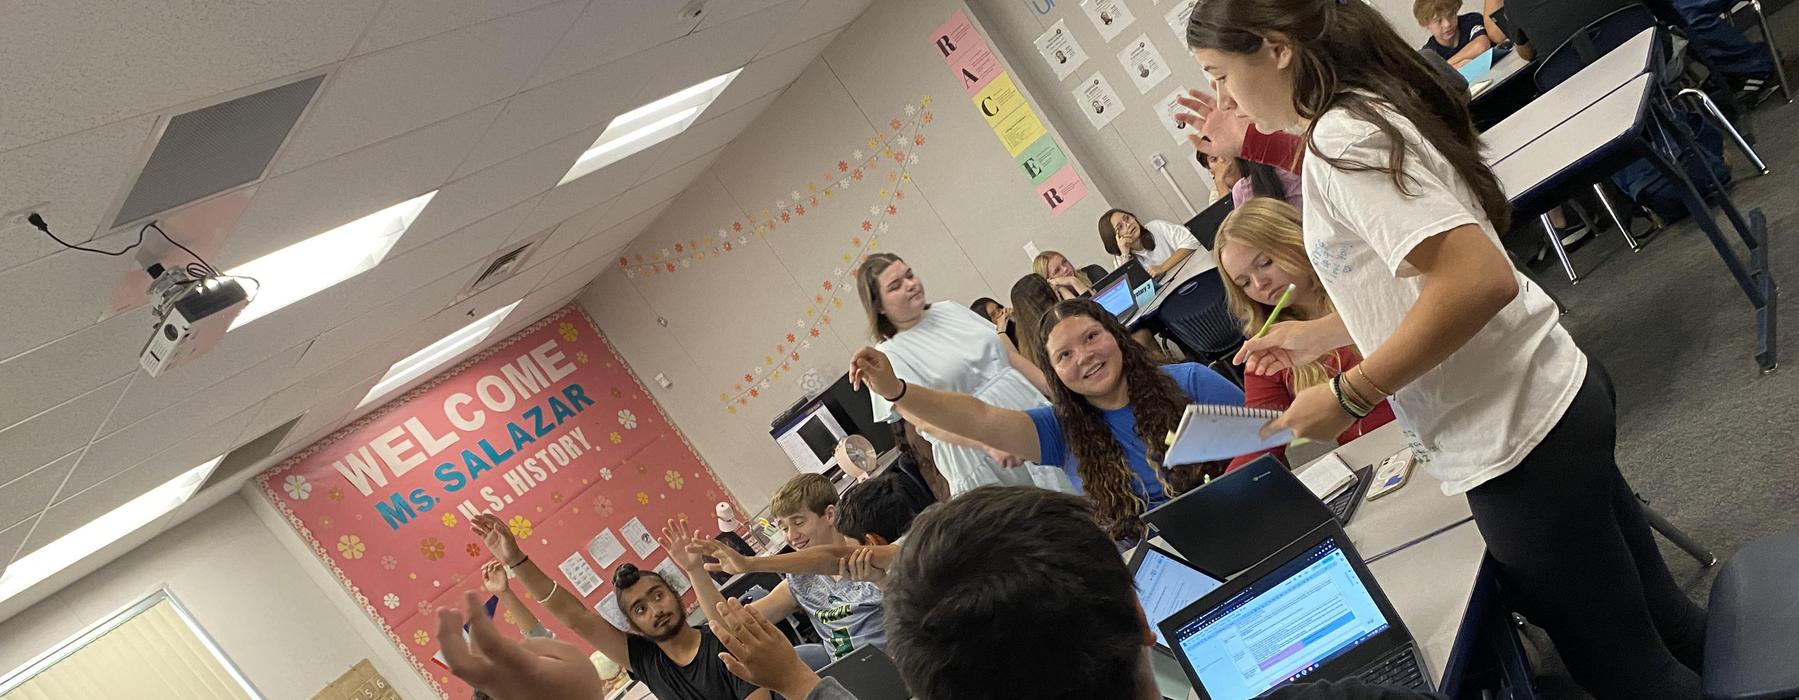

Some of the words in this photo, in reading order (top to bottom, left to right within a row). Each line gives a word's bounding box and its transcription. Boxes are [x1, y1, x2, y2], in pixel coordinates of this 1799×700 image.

[936, 35, 957, 58] R
[962, 68, 979, 89] A
[981, 96, 1000, 117] C
[1023, 157, 1042, 179] E
[1043, 188, 1065, 209] R
[332, 339, 577, 497] WELCOME
[374, 488, 441, 530] Ms.
[434, 383, 595, 492] SALAZAR
[365, 689, 373, 698] 5
[376, 680, 384, 689] 6
